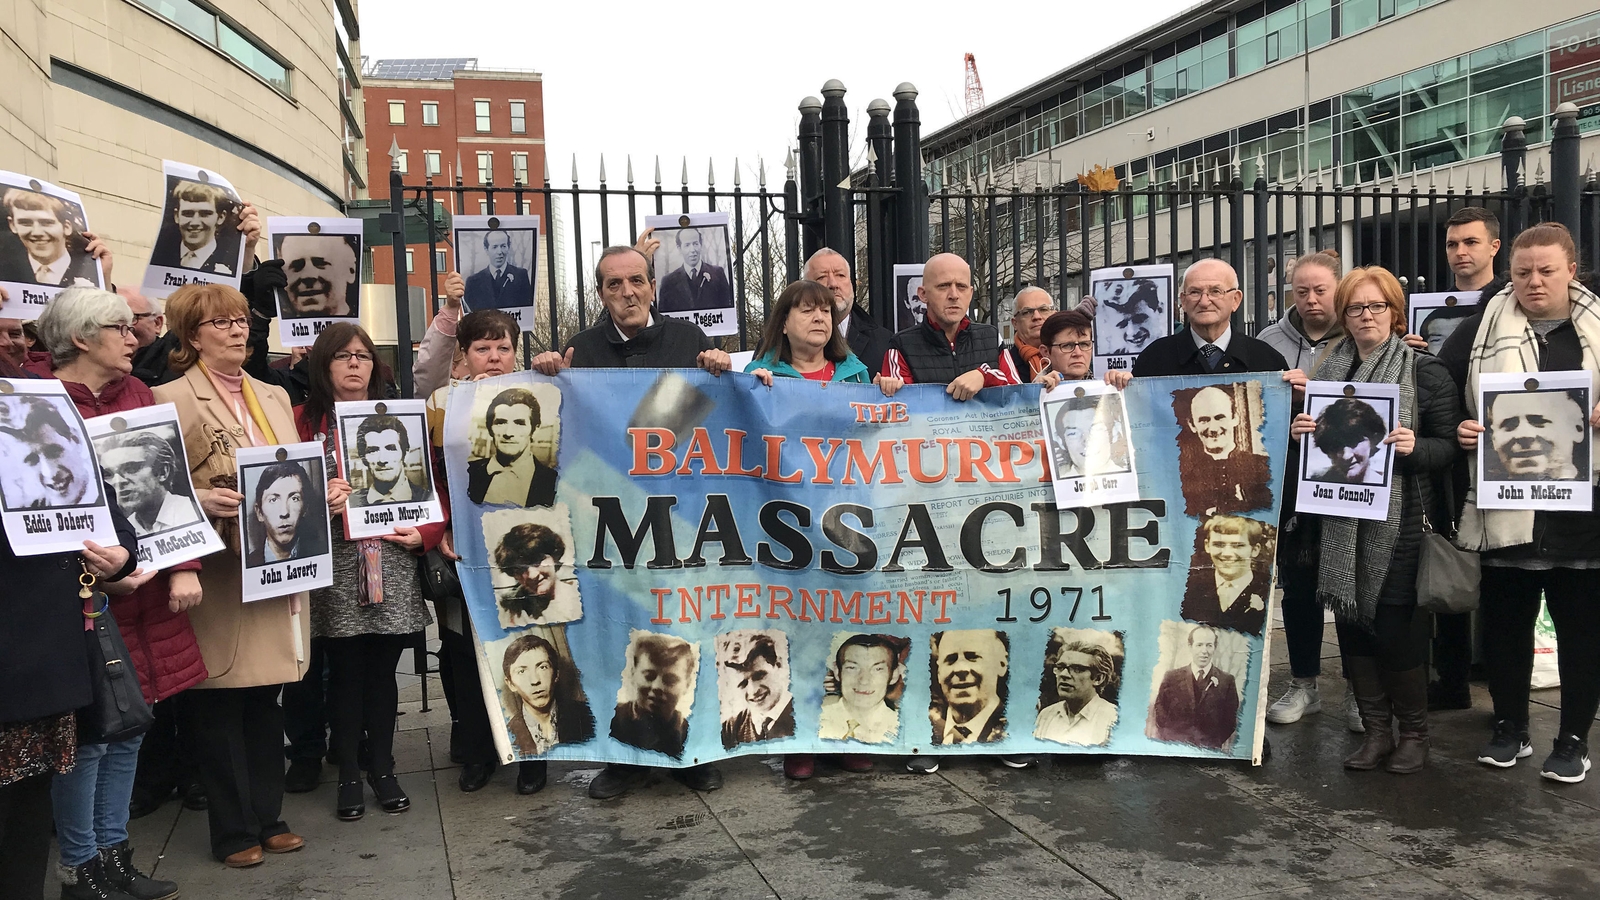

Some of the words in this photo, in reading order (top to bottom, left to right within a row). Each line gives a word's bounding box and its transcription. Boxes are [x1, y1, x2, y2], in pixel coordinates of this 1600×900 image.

[163, 272, 188, 286] Frank
[22, 289, 49, 305] Frank
[693, 311, 724, 327] Teggart
[291, 322, 310, 337] John
[1107, 357, 1128, 370] Eddie
[850, 402, 909, 424] THE
[965, 411, 978, 419] Act
[932, 427, 962, 436] ROYAL
[1101, 477, 1118, 490] Corr
[1497, 485, 1525, 500] John
[1530, 484, 1573, 500] McKerr
[930, 500, 963, 511] REPORT
[967, 498, 980, 506] OF
[1027, 489, 1048, 498] INTO
[1312, 484, 1334, 500] Joan
[1338, 486, 1376, 506] Connolly
[22, 513, 53, 534] Eddie
[55, 510, 95, 533] Doherty
[364, 508, 394, 526] Joseph
[397, 505, 430, 522] Murphy
[154, 530, 207, 556] McCarthy
[586, 494, 1171, 575] MASSACRE
[260, 567, 283, 586] John
[286, 560, 318, 581] Laverty
[650, 583, 957, 625] INTERNMENT
[995, 585, 1112, 623] 1971
